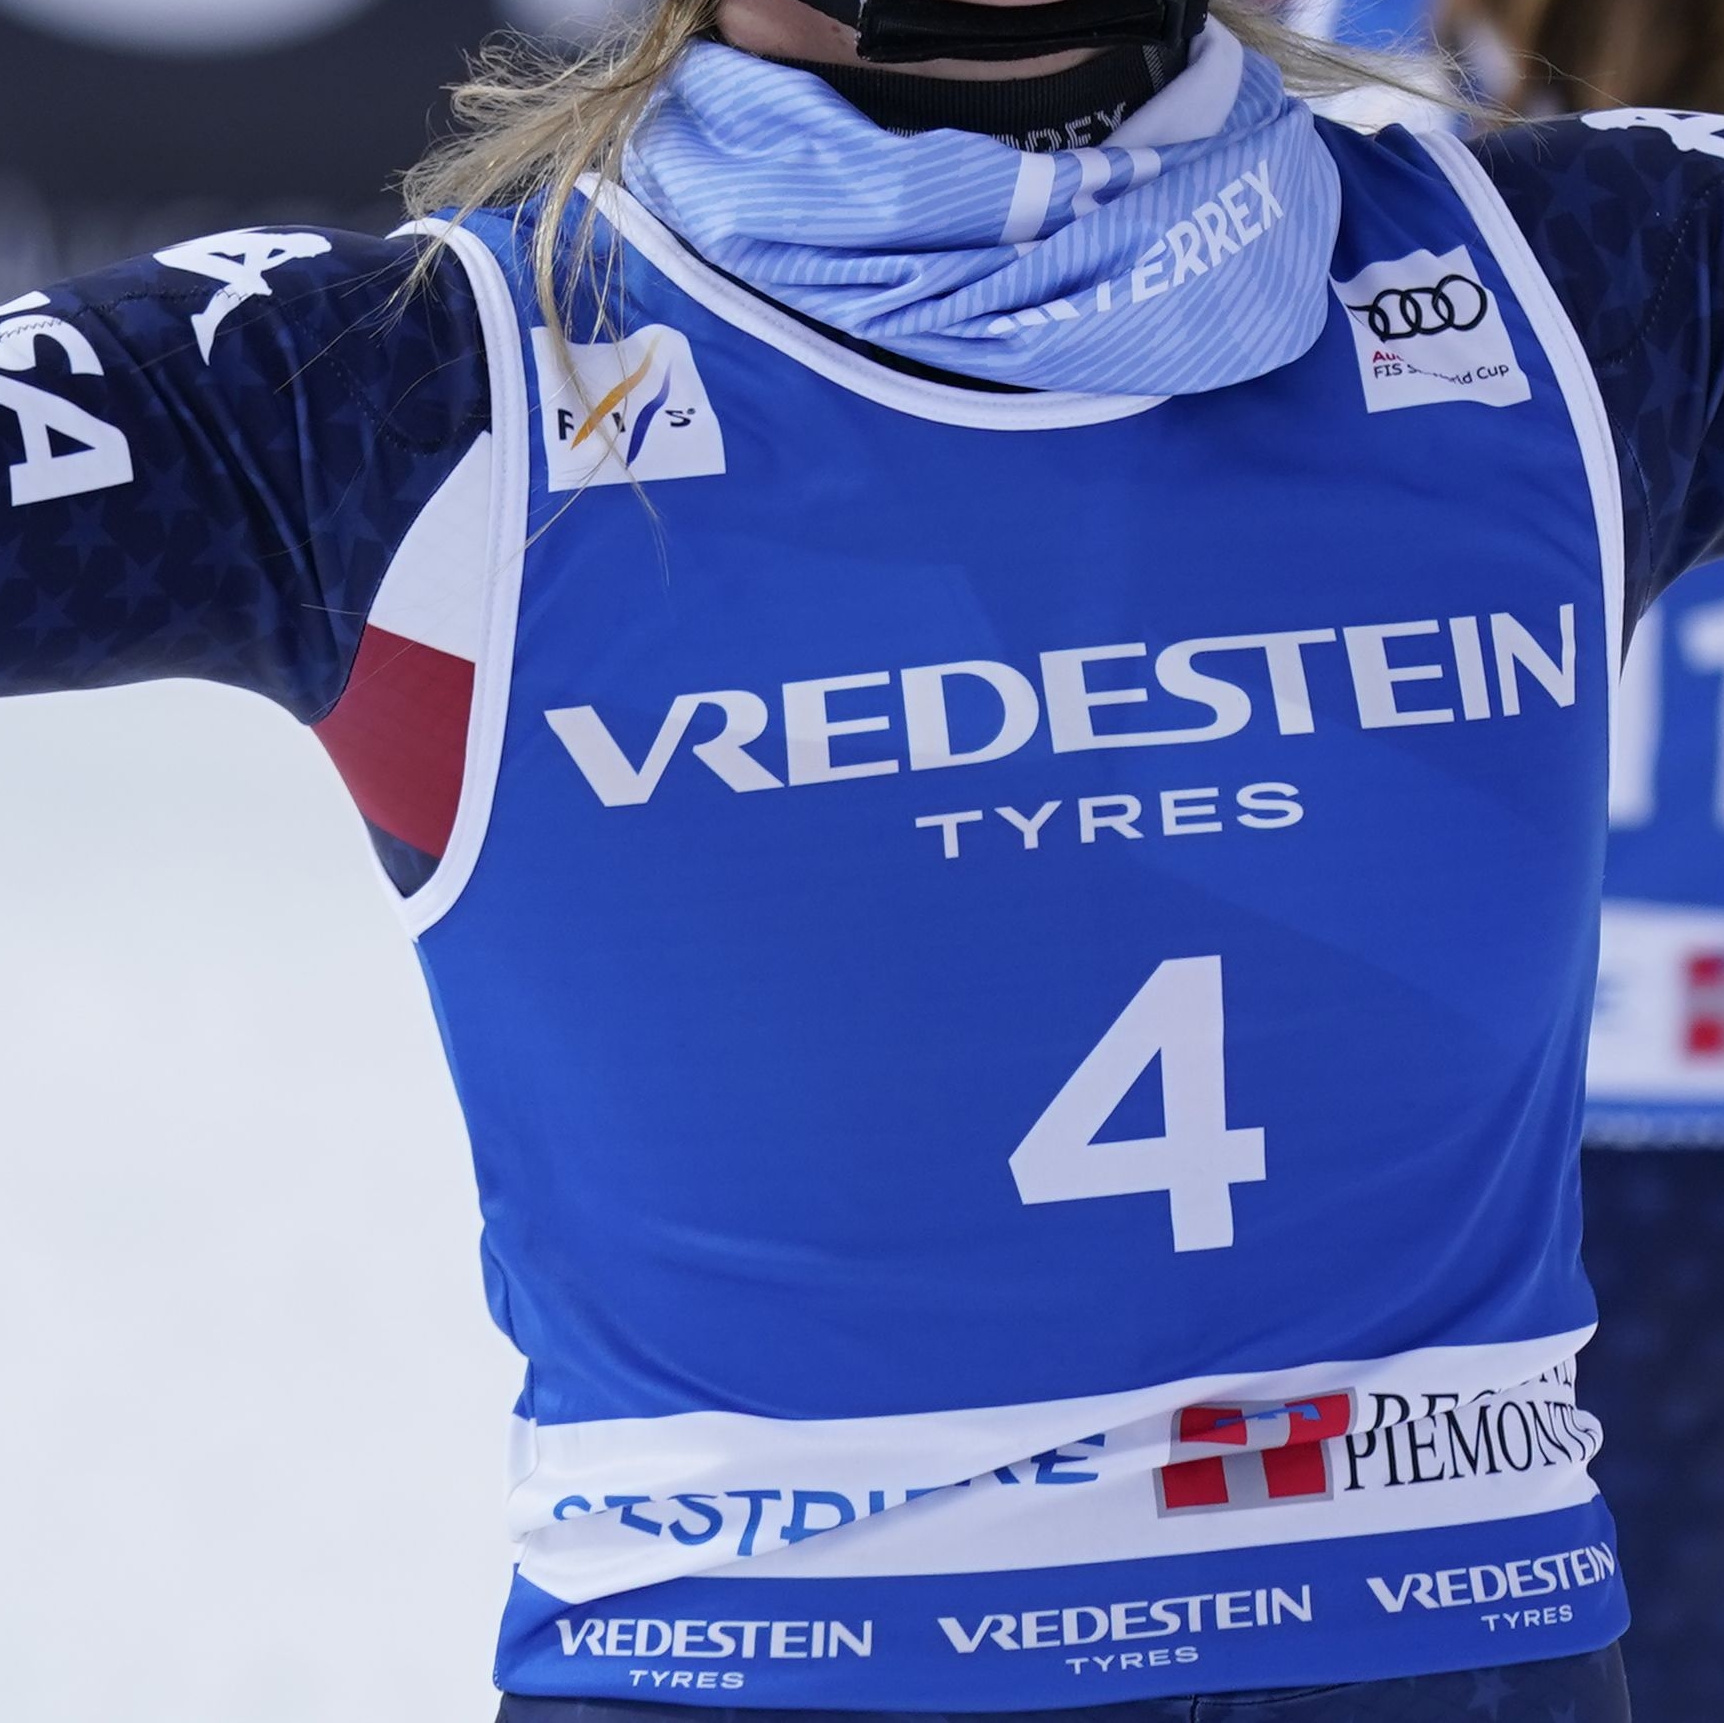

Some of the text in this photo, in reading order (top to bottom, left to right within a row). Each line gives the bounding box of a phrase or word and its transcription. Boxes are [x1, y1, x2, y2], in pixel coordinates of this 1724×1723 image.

[1477, 364, 1509, 380] Cup
[544, 604, 1575, 807] VREDESTEIN
[915, 782, 1304, 859] TYRES
[1007, 955, 1266, 1252] 4
[1366, 1542, 1615, 1613] VREDESTEIN
[556, 1618, 874, 1661] VREDESTEIN
[937, 1585, 1313, 1655] VREDESTEIN
[1481, 1605, 1573, 1632] TYRES
[629, 1670, 745, 1689] TYRES
[1065, 1646, 1198, 1675] TYRES
